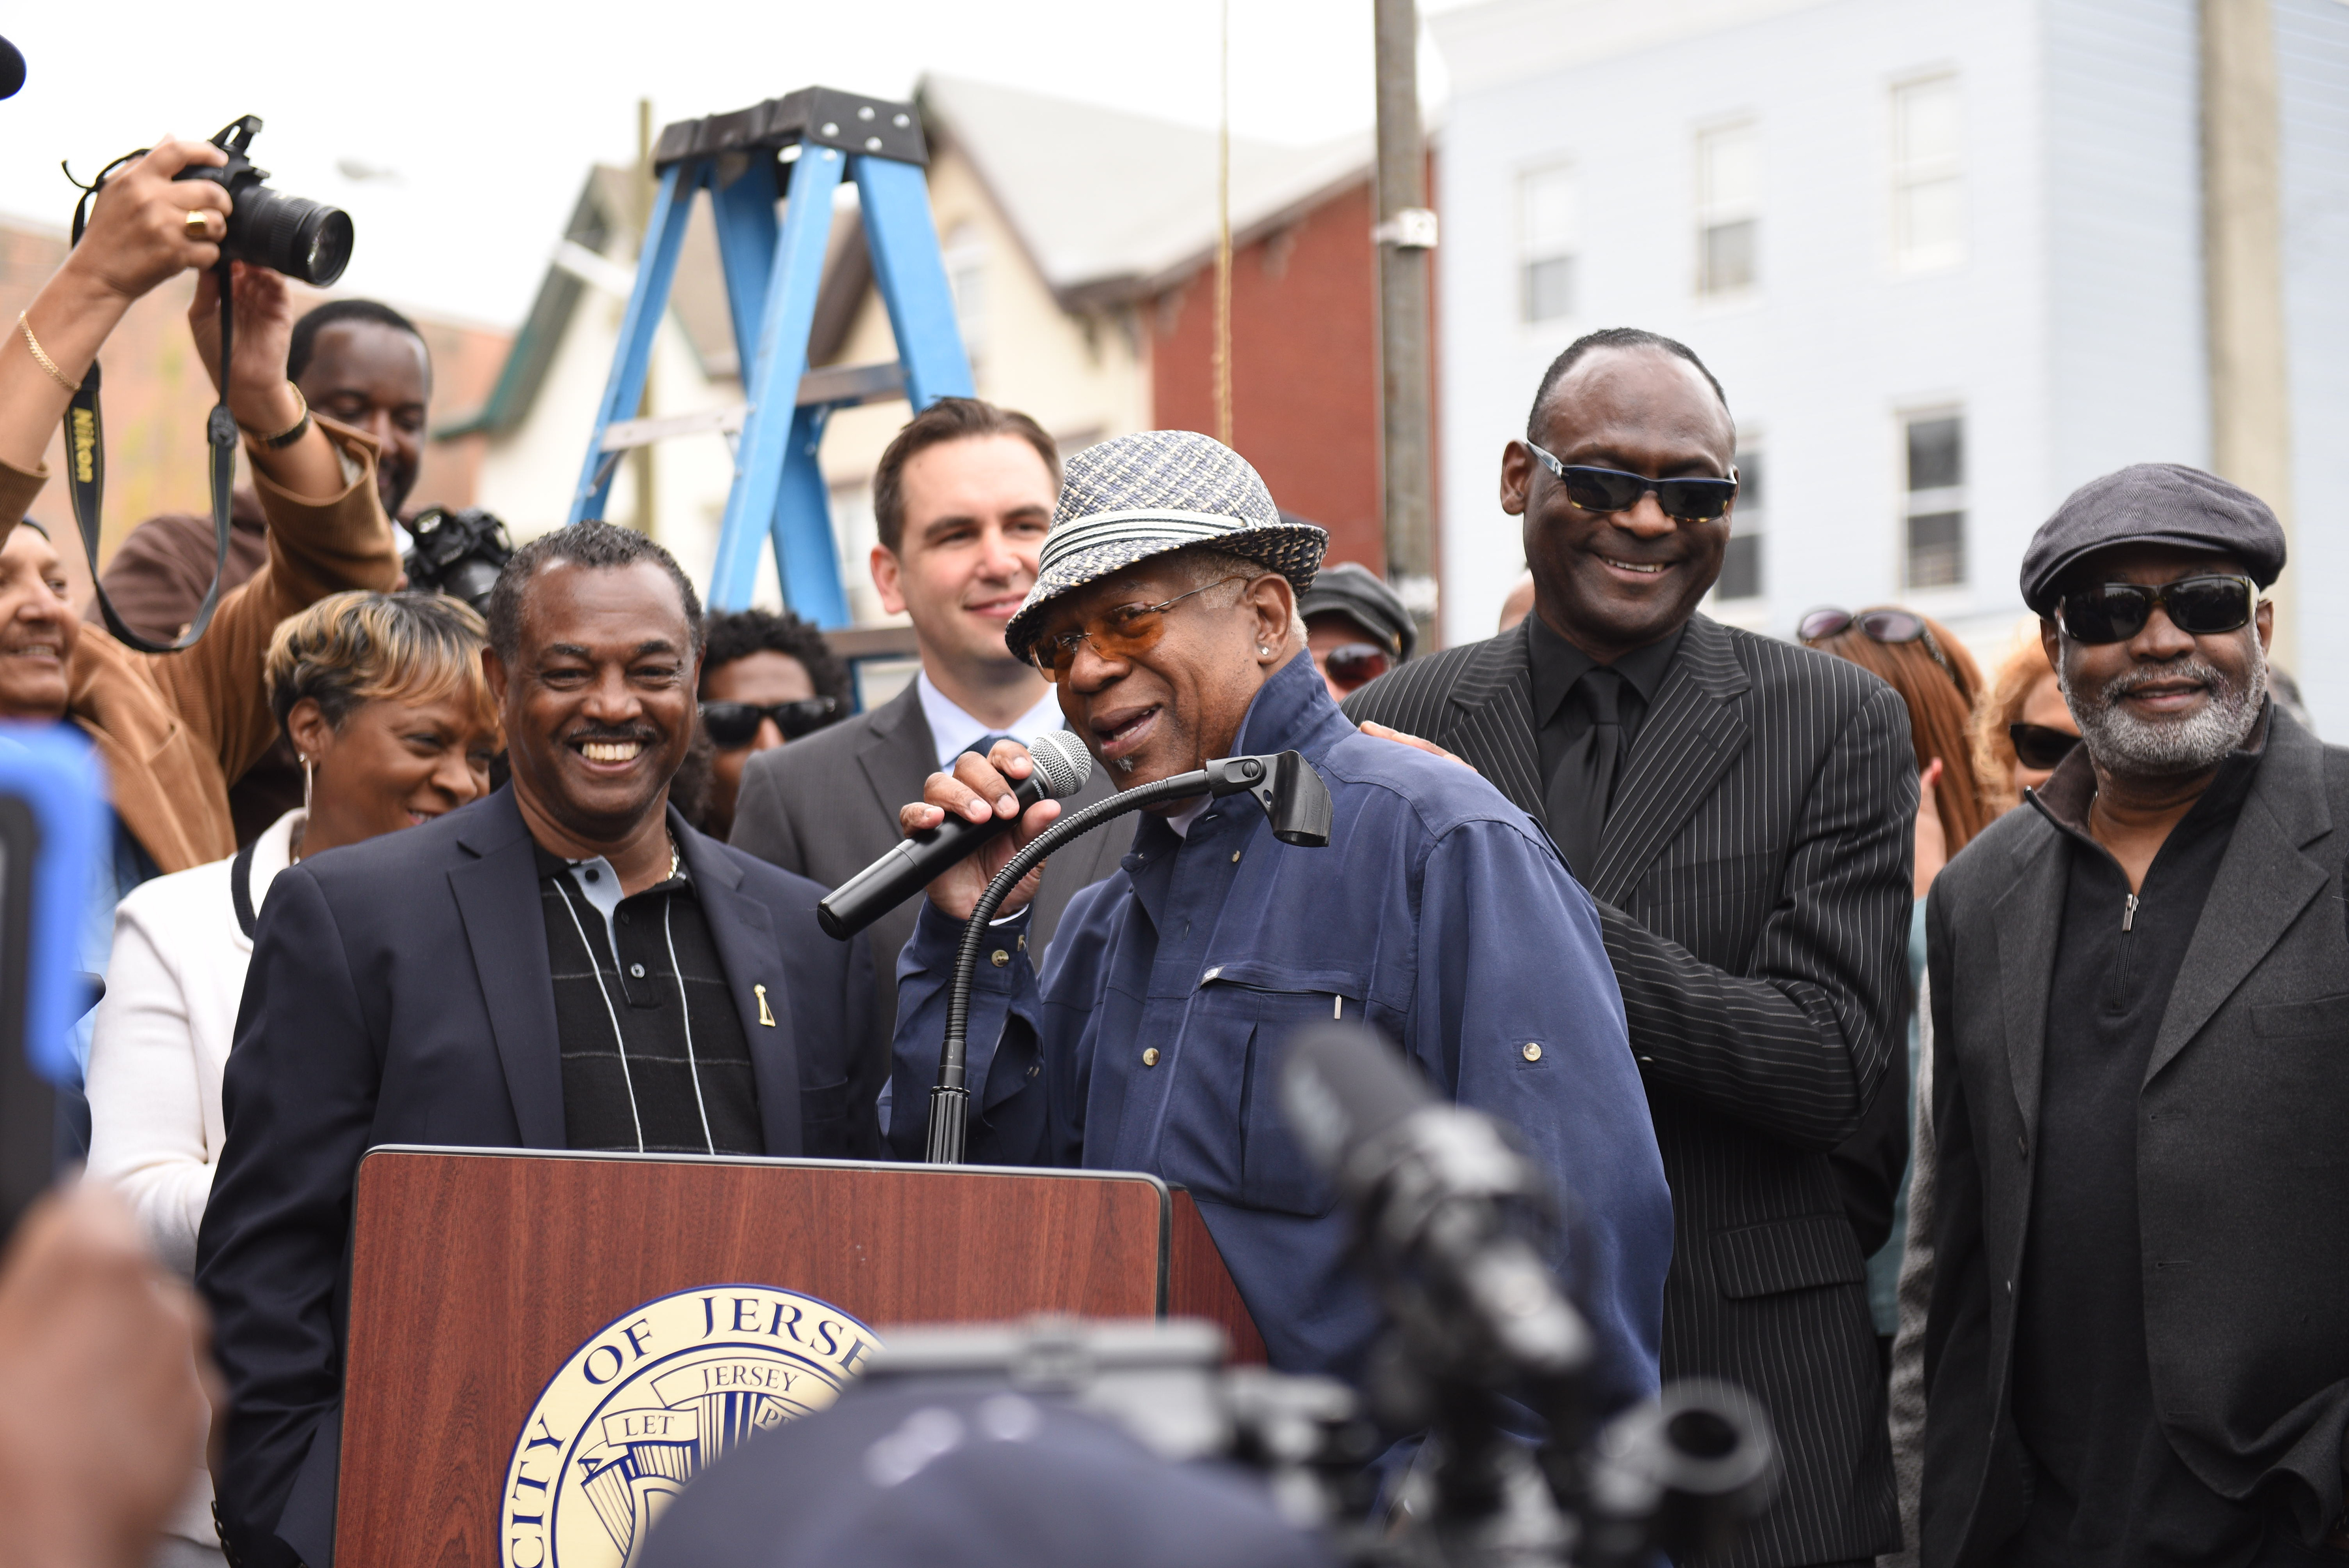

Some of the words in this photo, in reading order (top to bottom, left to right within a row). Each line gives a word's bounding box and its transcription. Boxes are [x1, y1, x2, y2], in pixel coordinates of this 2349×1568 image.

[72, 407, 95, 483] Nikon
[511, 1412, 567, 1568] CITY
[583, 1318, 653, 1385] OF
[699, 1296, 876, 1377] JERSE
[623, 1415, 675, 1437] LET
[702, 1364, 800, 1394] JERSEY
